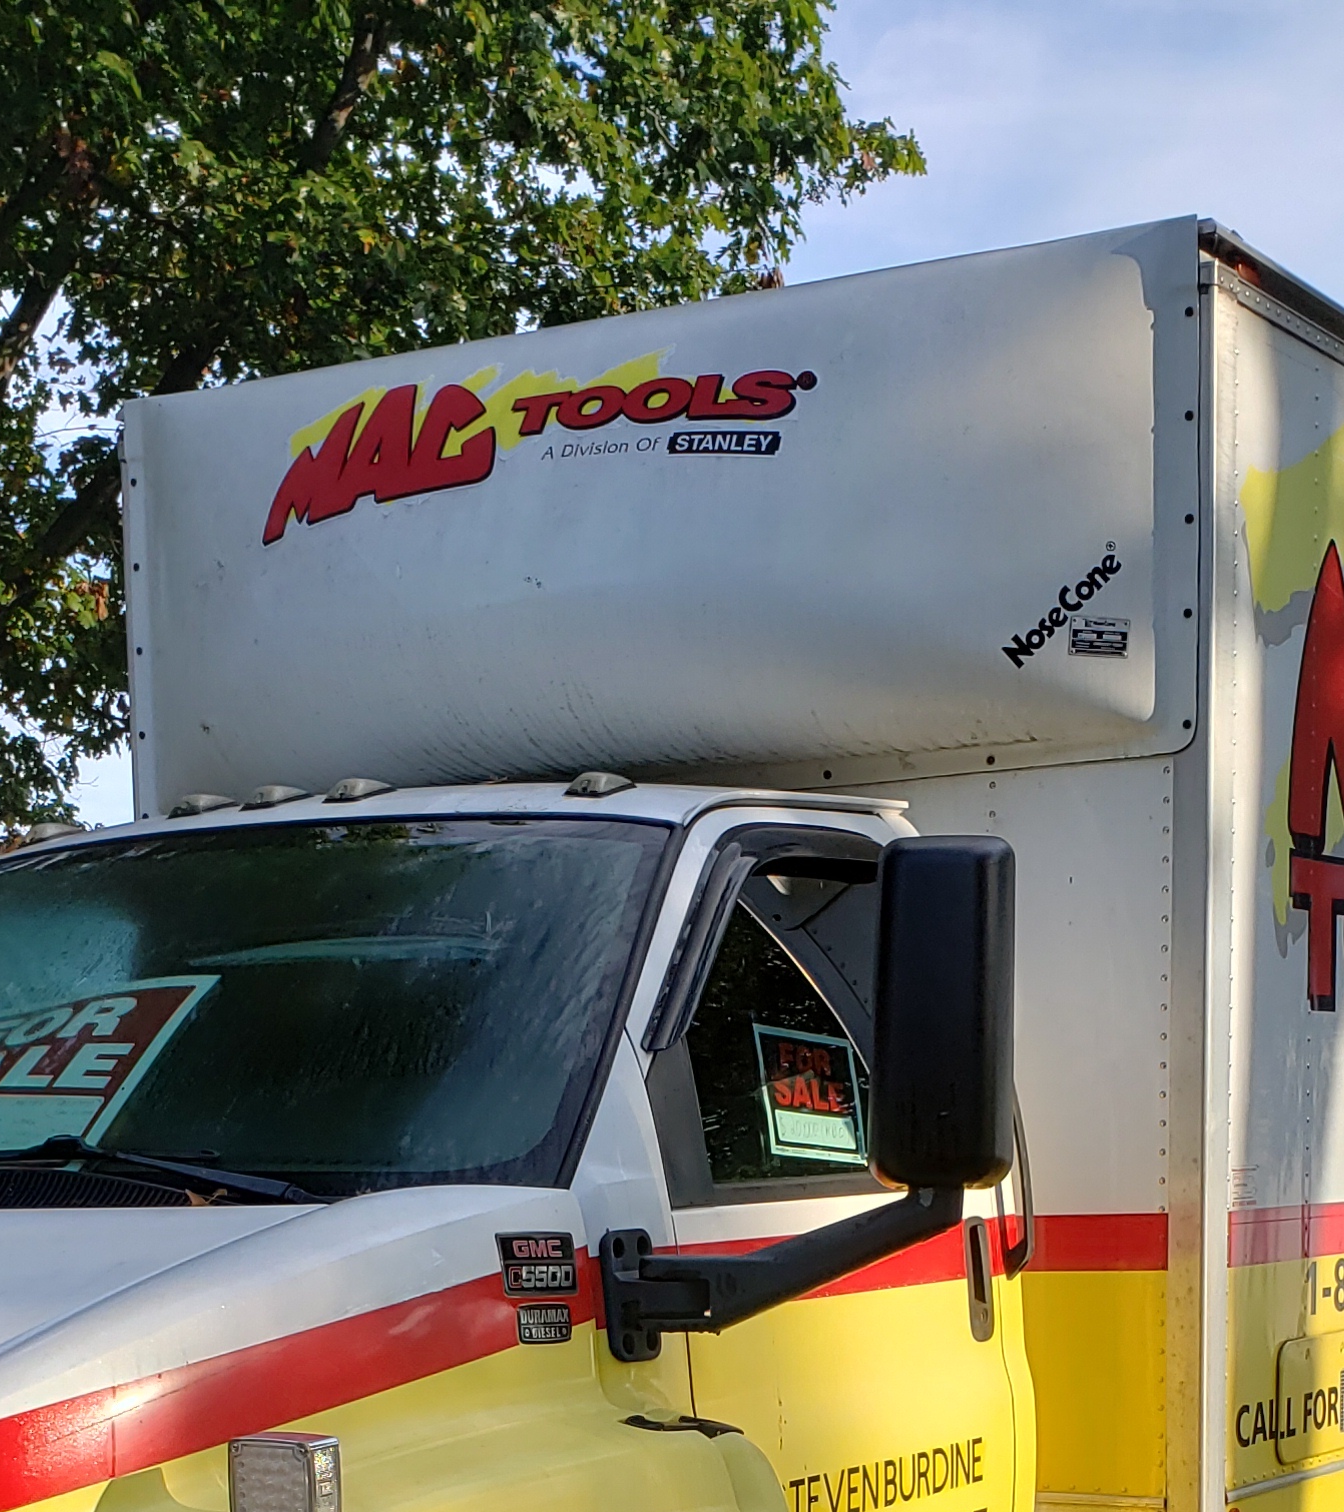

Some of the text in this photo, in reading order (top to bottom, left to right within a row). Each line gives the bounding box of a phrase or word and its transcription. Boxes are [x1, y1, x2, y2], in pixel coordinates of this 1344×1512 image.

[541, 434, 774, 460] A Division Of STANLEY
[262, 384, 496, 546] MAC
[778, 1042, 832, 1077] FOR
[773, 1075, 848, 1114] SALE
[512, 1239, 563, 1258] GMC
[508, 1265, 574, 1289] C5500
[519, 1308, 570, 1325] DURAMAX
[532, 1326, 561, 1339] DIESEL
[1235, 1397, 1297, 1448] CALL
[1302, 1386, 1339, 1434] FOR
